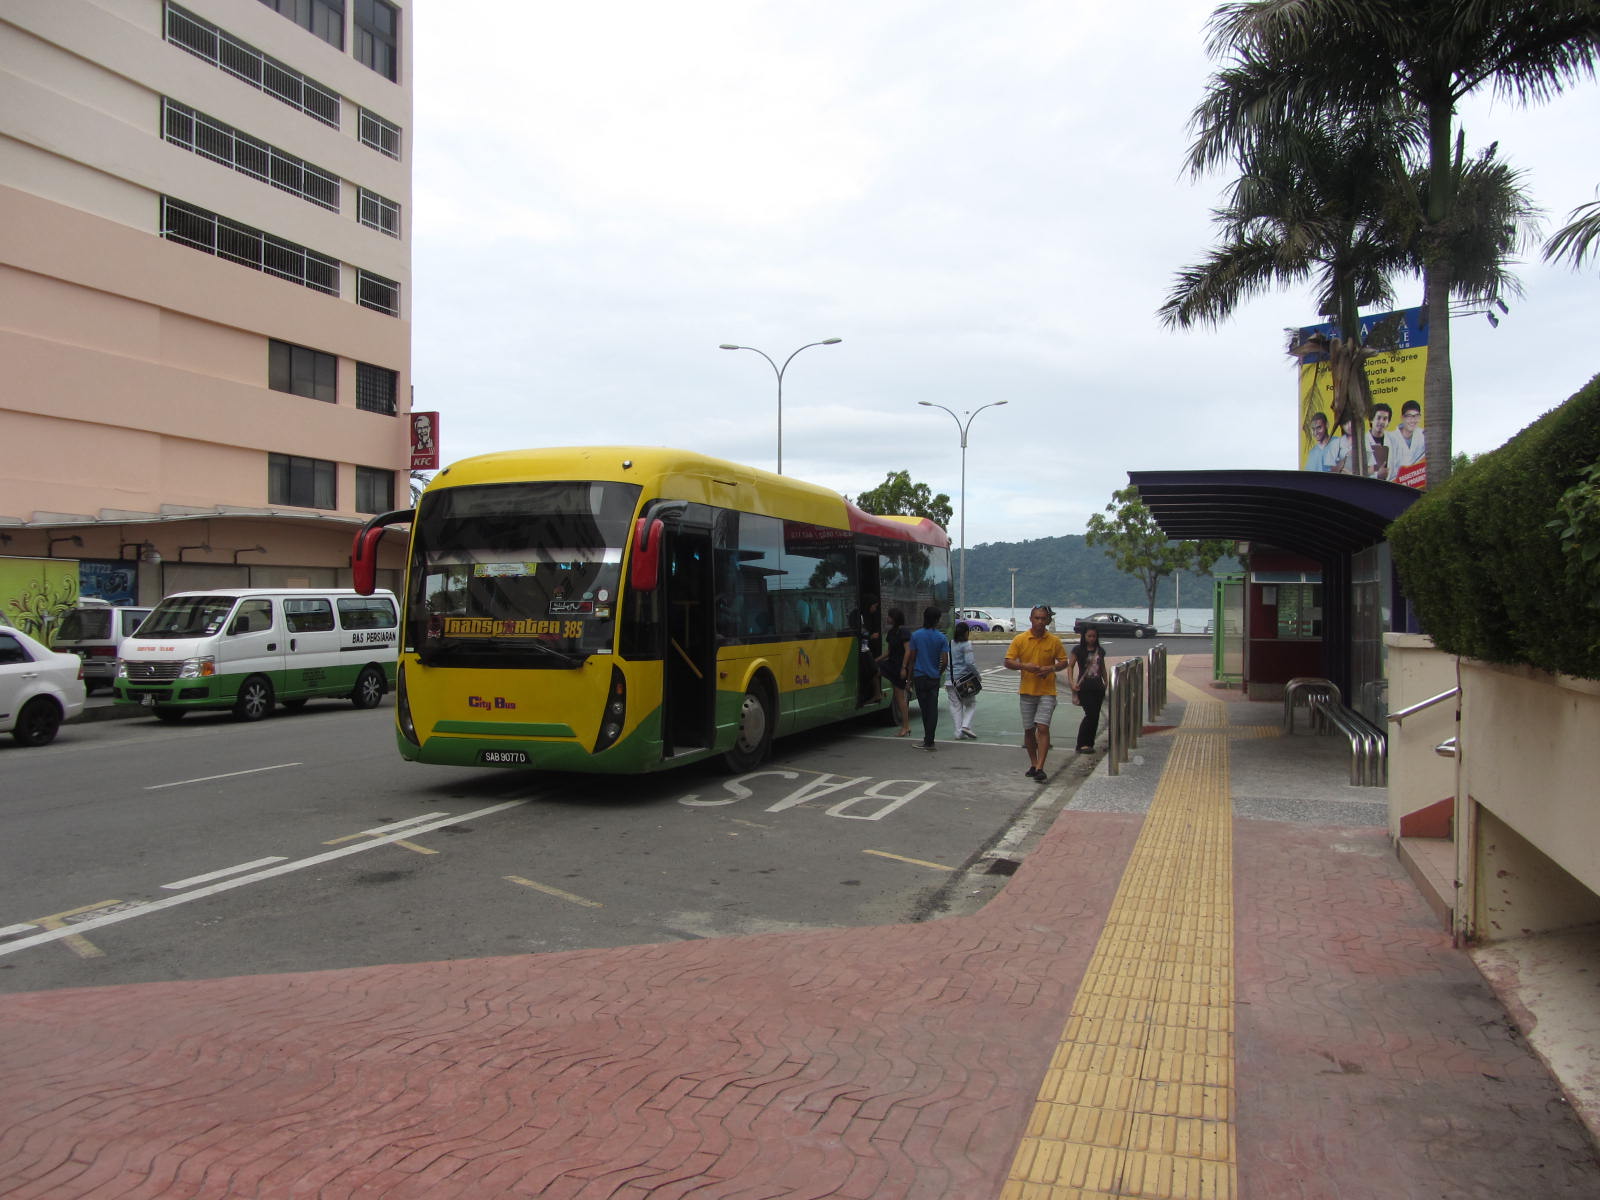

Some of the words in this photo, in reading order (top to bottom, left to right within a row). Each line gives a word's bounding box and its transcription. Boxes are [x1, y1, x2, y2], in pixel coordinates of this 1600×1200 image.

[1391, 354, 1418, 363] Degree
[1376, 376, 1406, 385] Science
[1370, 386, 1398, 395] ailable
[414, 457, 432, 466] KFC
[563, 620, 583, 638] 385
[352, 633, 363, 643] BAS
[366, 631, 396, 643] PERSIARAN
[468, 696, 491, 711] City
[494, 697, 516, 709] Bus
[485, 752, 500, 762] SAB
[678, 770, 940, 821] BAS
